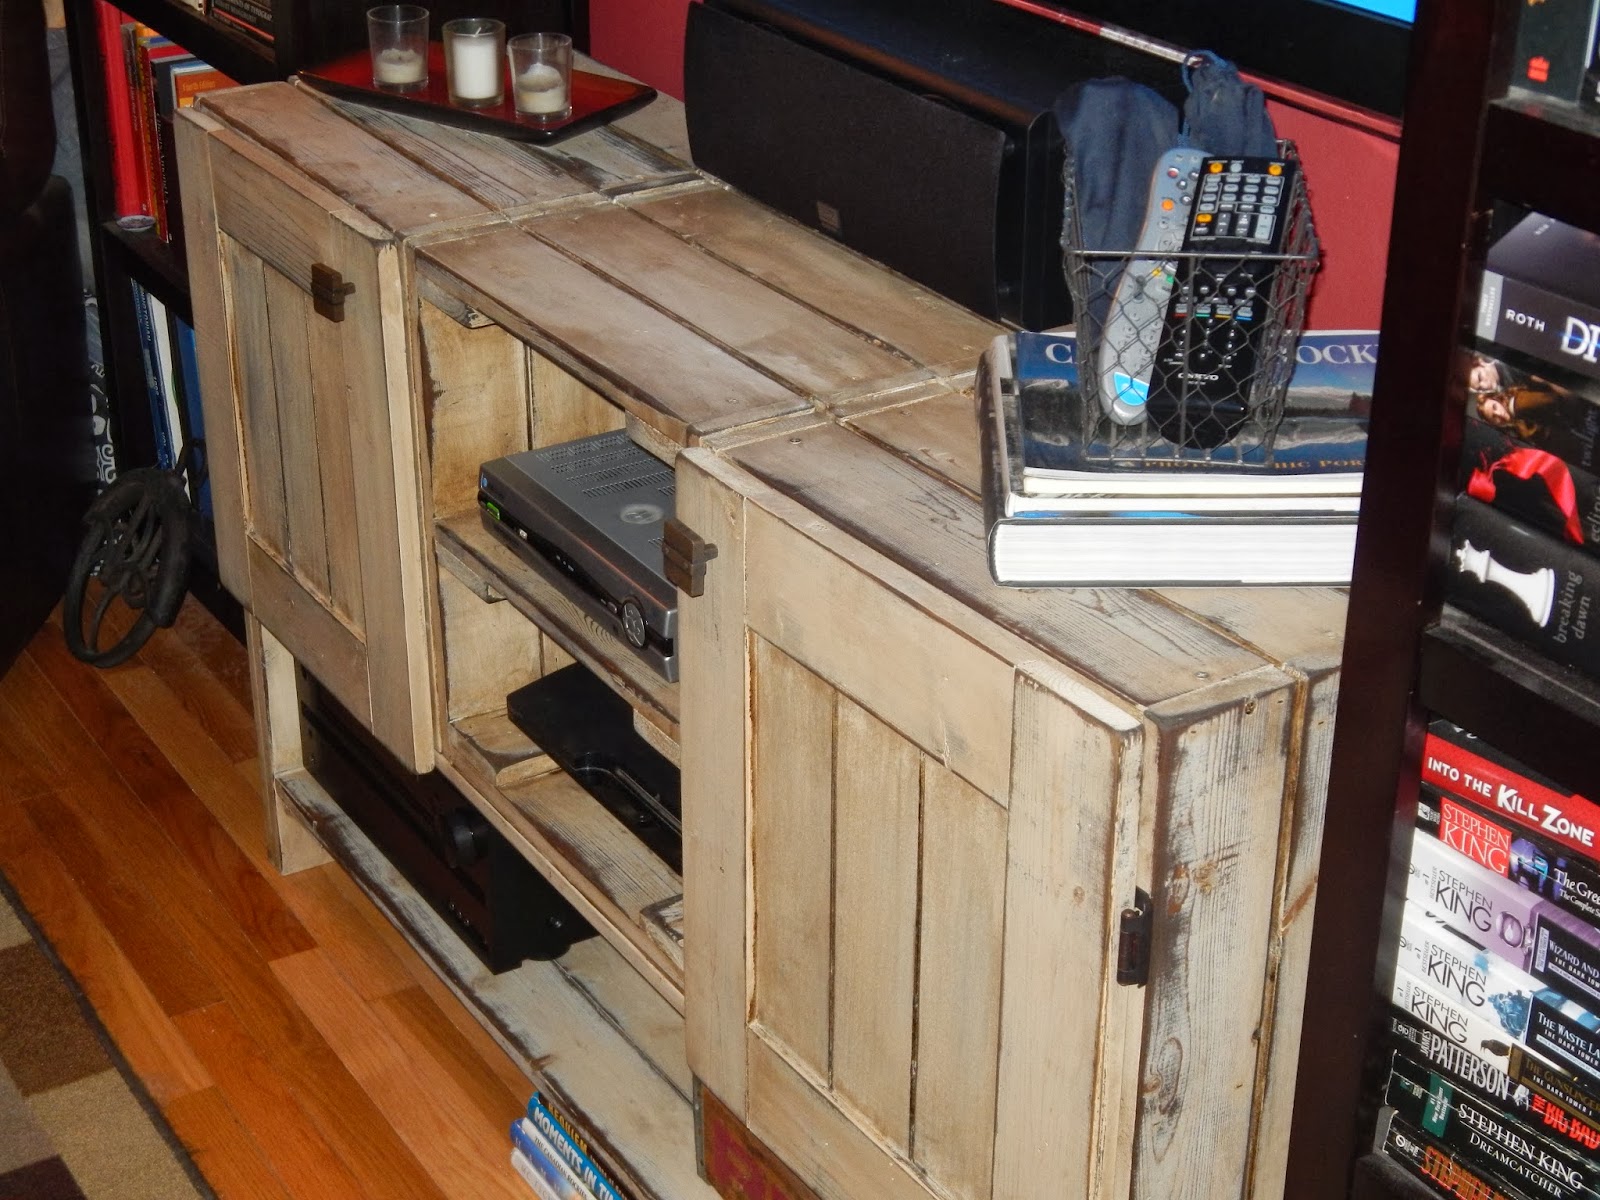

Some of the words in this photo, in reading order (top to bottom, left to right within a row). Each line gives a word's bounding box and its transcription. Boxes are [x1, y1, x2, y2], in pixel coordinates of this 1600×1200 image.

[1505, 309, 1546, 332] ROTH
[1296, 343, 1378, 365] OCK
[1553, 570, 1583, 644] breaking
[1572, 595, 1592, 640] dawn
[1428, 757, 1459, 781] INTO
[1464, 774, 1492, 798] THE
[1497, 784, 1539, 822] KILL
[1541, 804, 1595, 847] ZONE
[1443, 803, 1510, 851] STEPHEN
[1443, 820, 1509, 875] KING
[1429, 866, 1438, 900] BESTSELLER
[1438, 870, 1493, 911] STEPHEN
[1553, 868, 1575, 890] The
[1435, 881, 1492, 932] KING
[1559, 889, 1570, 901] The
[1570, 895, 1595, 914] Complete
[1421, 941, 1430, 973] BESTSELLER
[1430, 944, 1487, 986] STEPHEN
[1549, 939, 1580, 967] WIZARD
[1581, 962, 1600, 979] AND
[1555, 957, 1566, 968] THE
[1568, 964, 1585, 980] DARK
[1428, 955, 1485, 1007] KING
[1411, 995, 1467, 1043] KING
[1413, 986, 1469, 1027] STEPHEN
[1420, 1029, 1431, 1057] JAMES
[1538, 1012, 1556, 1031] THE
[1558, 1023, 1587, 1050] WASTE
[1544, 1029, 1555, 1040] THE
[1558, 1038, 1575, 1053] DARK
[1578, 1048, 1599, 1067] TOWER
[1429, 1033, 1509, 1101] PATTERSON
[1525, 1058, 1541, 1074] THE
[1533, 1075, 1544, 1087] THE
[1547, 1083, 1563, 1098] DARK
[1566, 1095, 1587, 1113] TOWER
[548, 1102, 588, 1155] REQUIEM
[1458, 1103, 1535, 1160] STEPHEN
[1537, 1149, 1583, 1190] KING
[1544, 1101, 1568, 1134] BIG
[1569, 1118, 1600, 1150] BAD
[534, 1106, 583, 1174] MOMENTS
[584, 1166, 597, 1191] IN
[534, 1136, 544, 1151] THE
[543, 1145, 568, 1179] CANADIAN
[567, 1174, 588, 1200] ROCKIES
[1469, 1132, 1563, 1198] DREAMCATCHER
